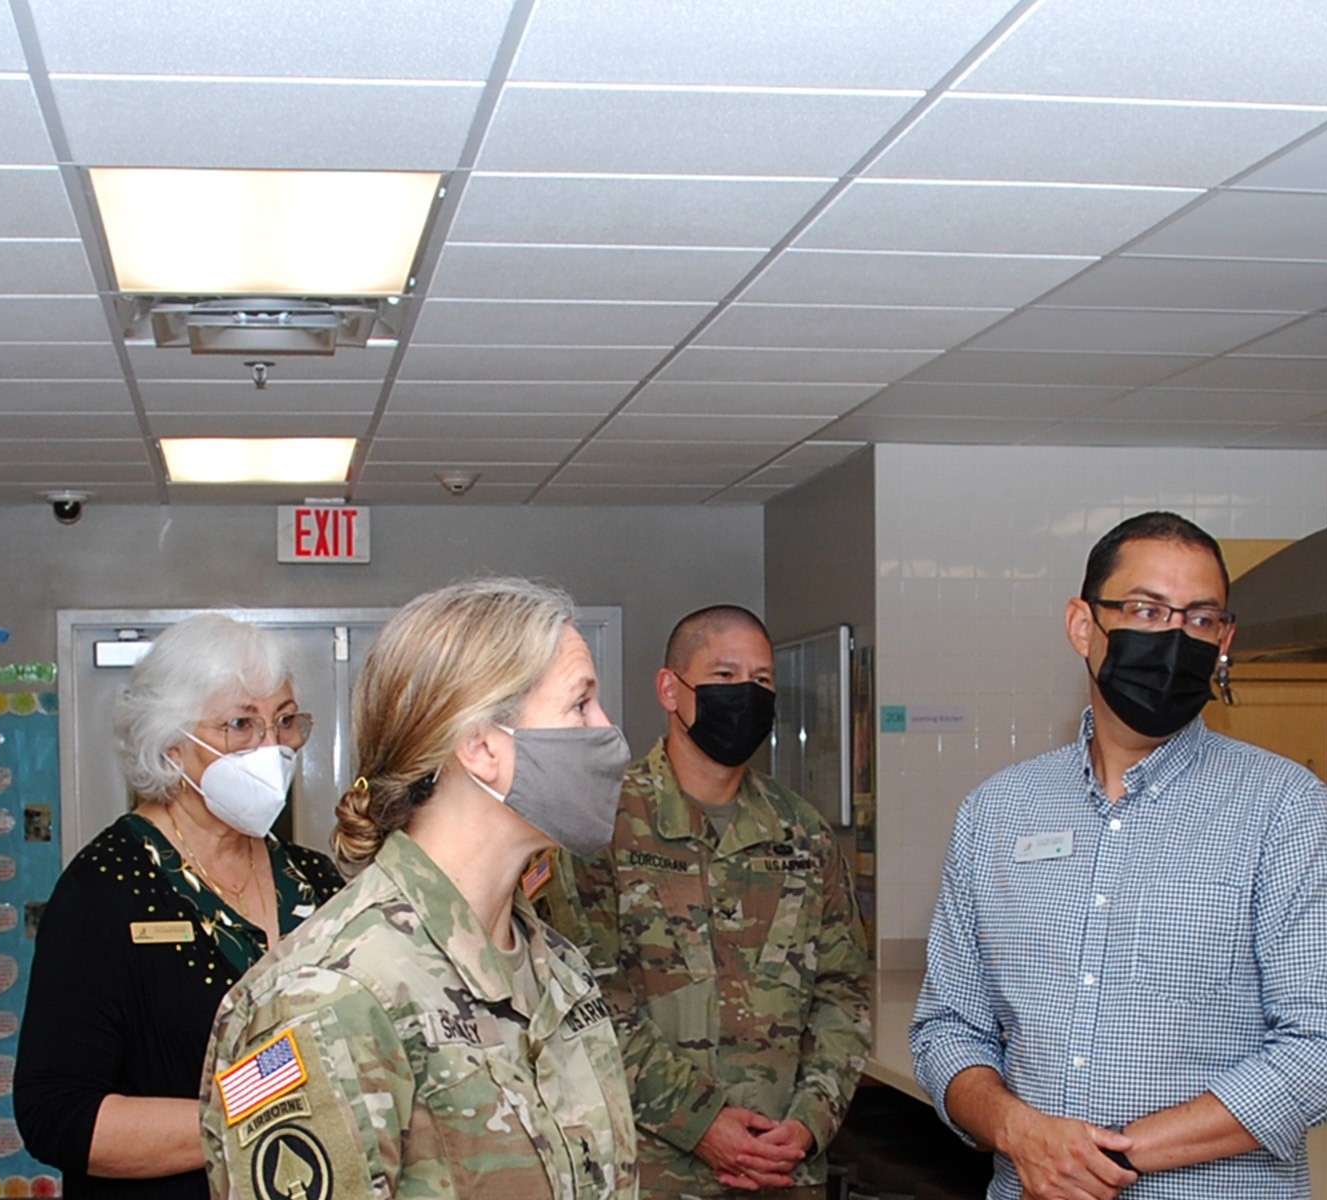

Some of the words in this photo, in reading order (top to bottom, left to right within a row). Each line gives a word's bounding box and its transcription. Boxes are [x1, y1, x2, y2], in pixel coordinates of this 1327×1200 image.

[295, 509, 358, 557] EXIT
[629, 851, 688, 872] CORCORAN
[246, 1097, 304, 1137] AIRBORNE
